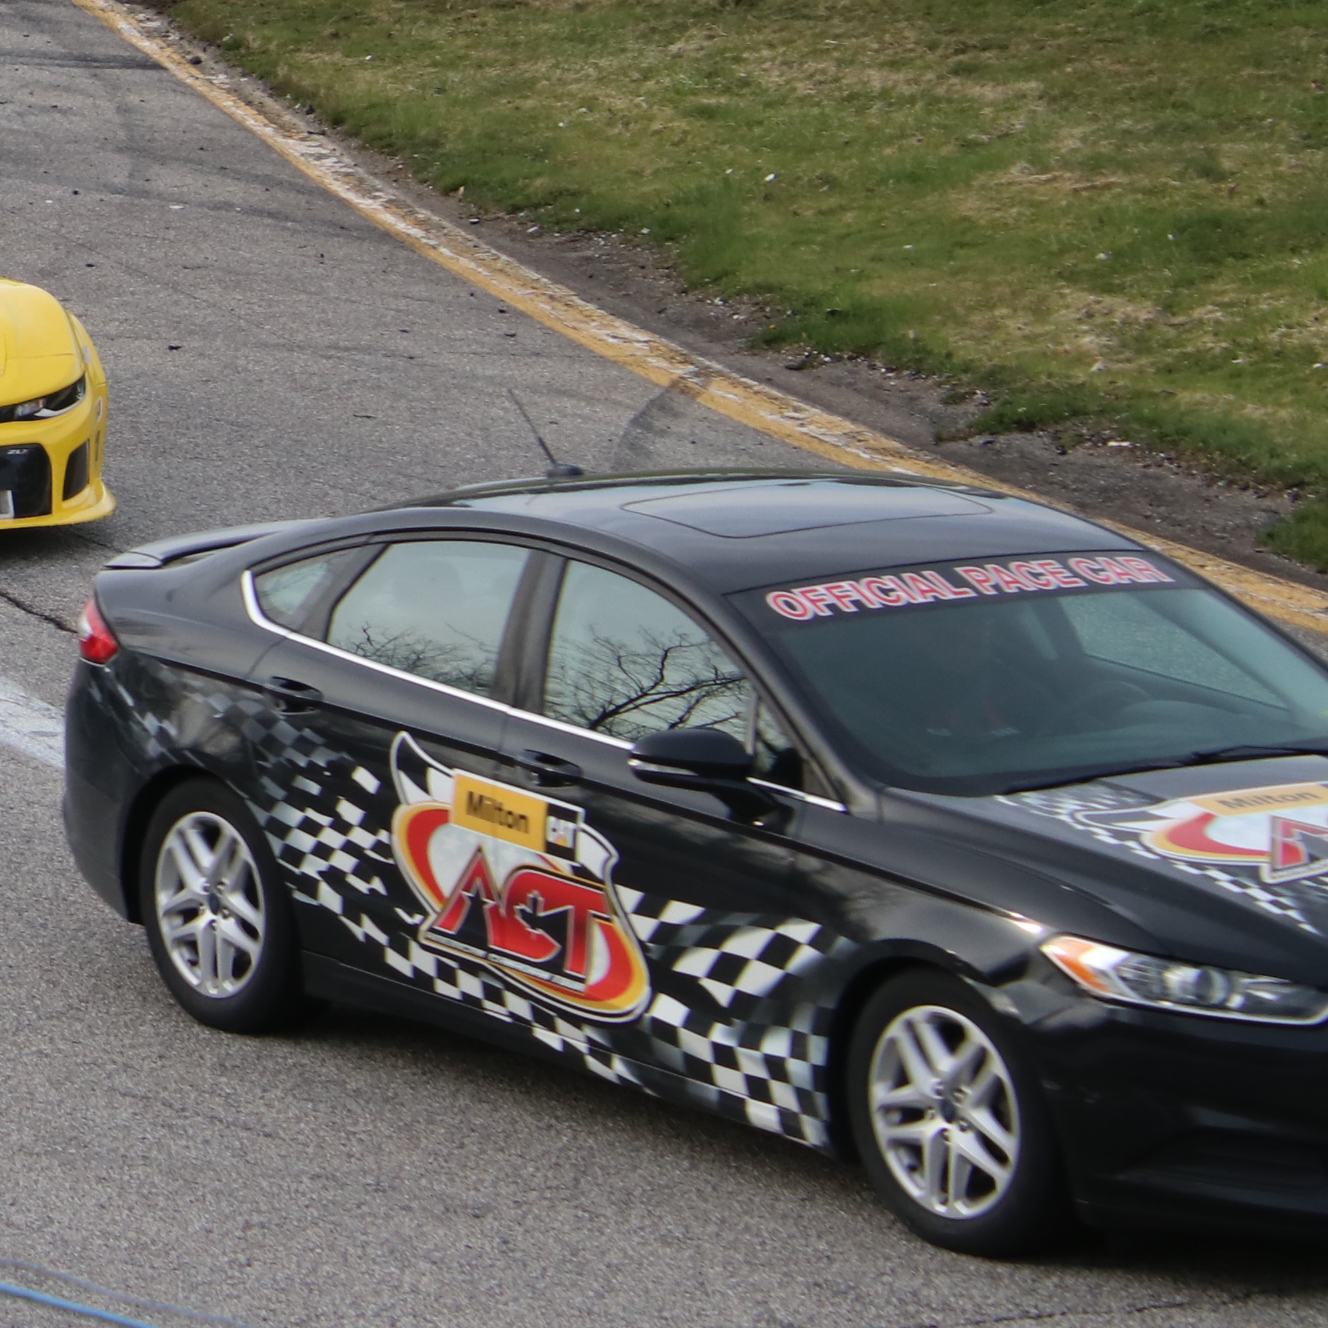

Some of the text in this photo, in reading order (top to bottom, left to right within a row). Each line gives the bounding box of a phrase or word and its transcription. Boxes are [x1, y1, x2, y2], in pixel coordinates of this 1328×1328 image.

[765, 556, 1176, 621] OFFICIAL PACE CAR
[466, 789, 529, 835] Milton
[1217, 791, 1321, 810] Milton
[431, 843, 613, 980] ACT
